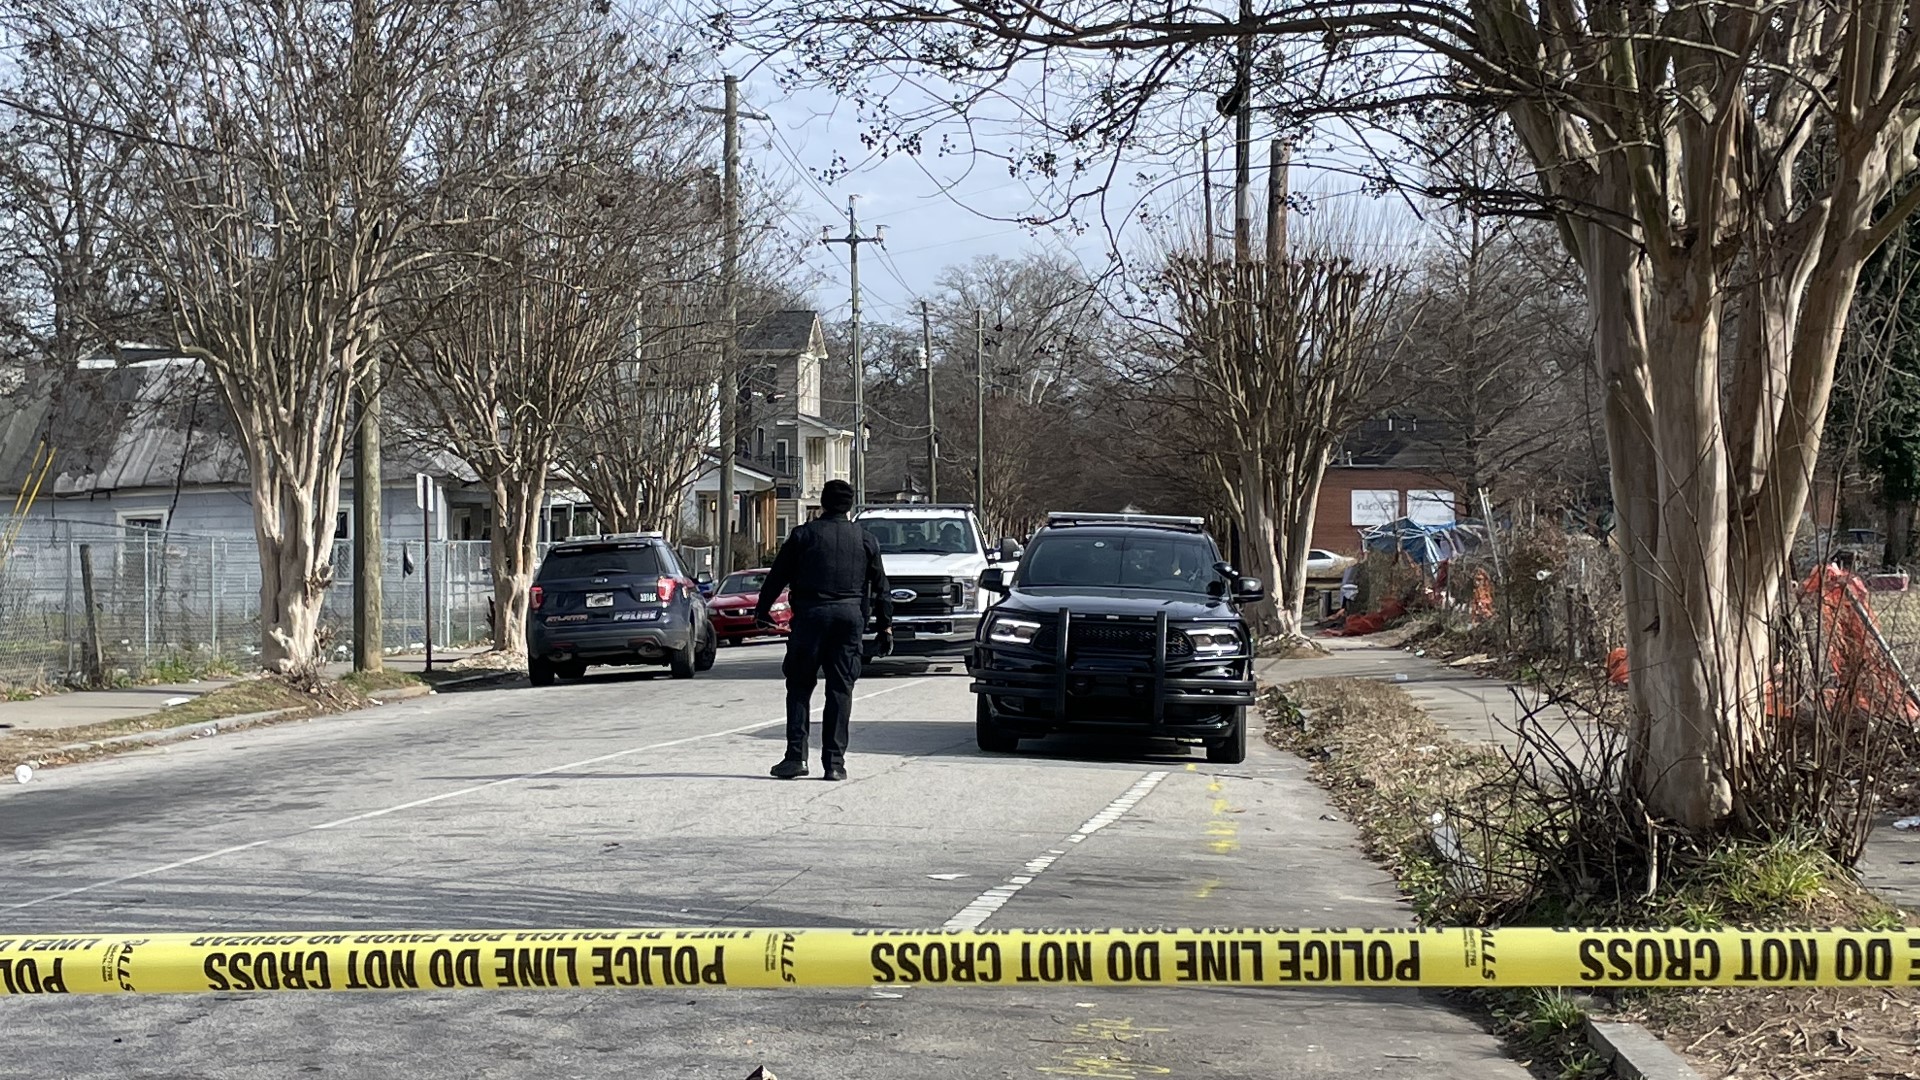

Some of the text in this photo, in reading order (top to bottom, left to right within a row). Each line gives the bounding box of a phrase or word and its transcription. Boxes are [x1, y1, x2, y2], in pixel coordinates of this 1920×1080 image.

[613, 610, 658, 621] POLICE
[18, 939, 101, 951] LINEA
[190, 935, 303, 946] CRUZAR
[781, 932, 797, 983] ALLS
[1107, 940, 1161, 981] DO
[1175, 940, 1263, 981] LINE
[1278, 940, 1420, 981] POLICE
[1579, 938, 1720, 981] CROSS
[1733, 938, 1817, 981] NOT
[1835, 938, 1892, 981] DO
[117, 944, 136, 992] ALLS
[203, 950, 331, 990] CROSS
[345, 949, 419, 989] NOT
[429, 948, 484, 988] DO
[494, 947, 580, 987] LINE
[592, 945, 727, 986] POLICE
[871, 942, 1001, 983] CROSS
[1016, 941, 1093, 982] NOT
